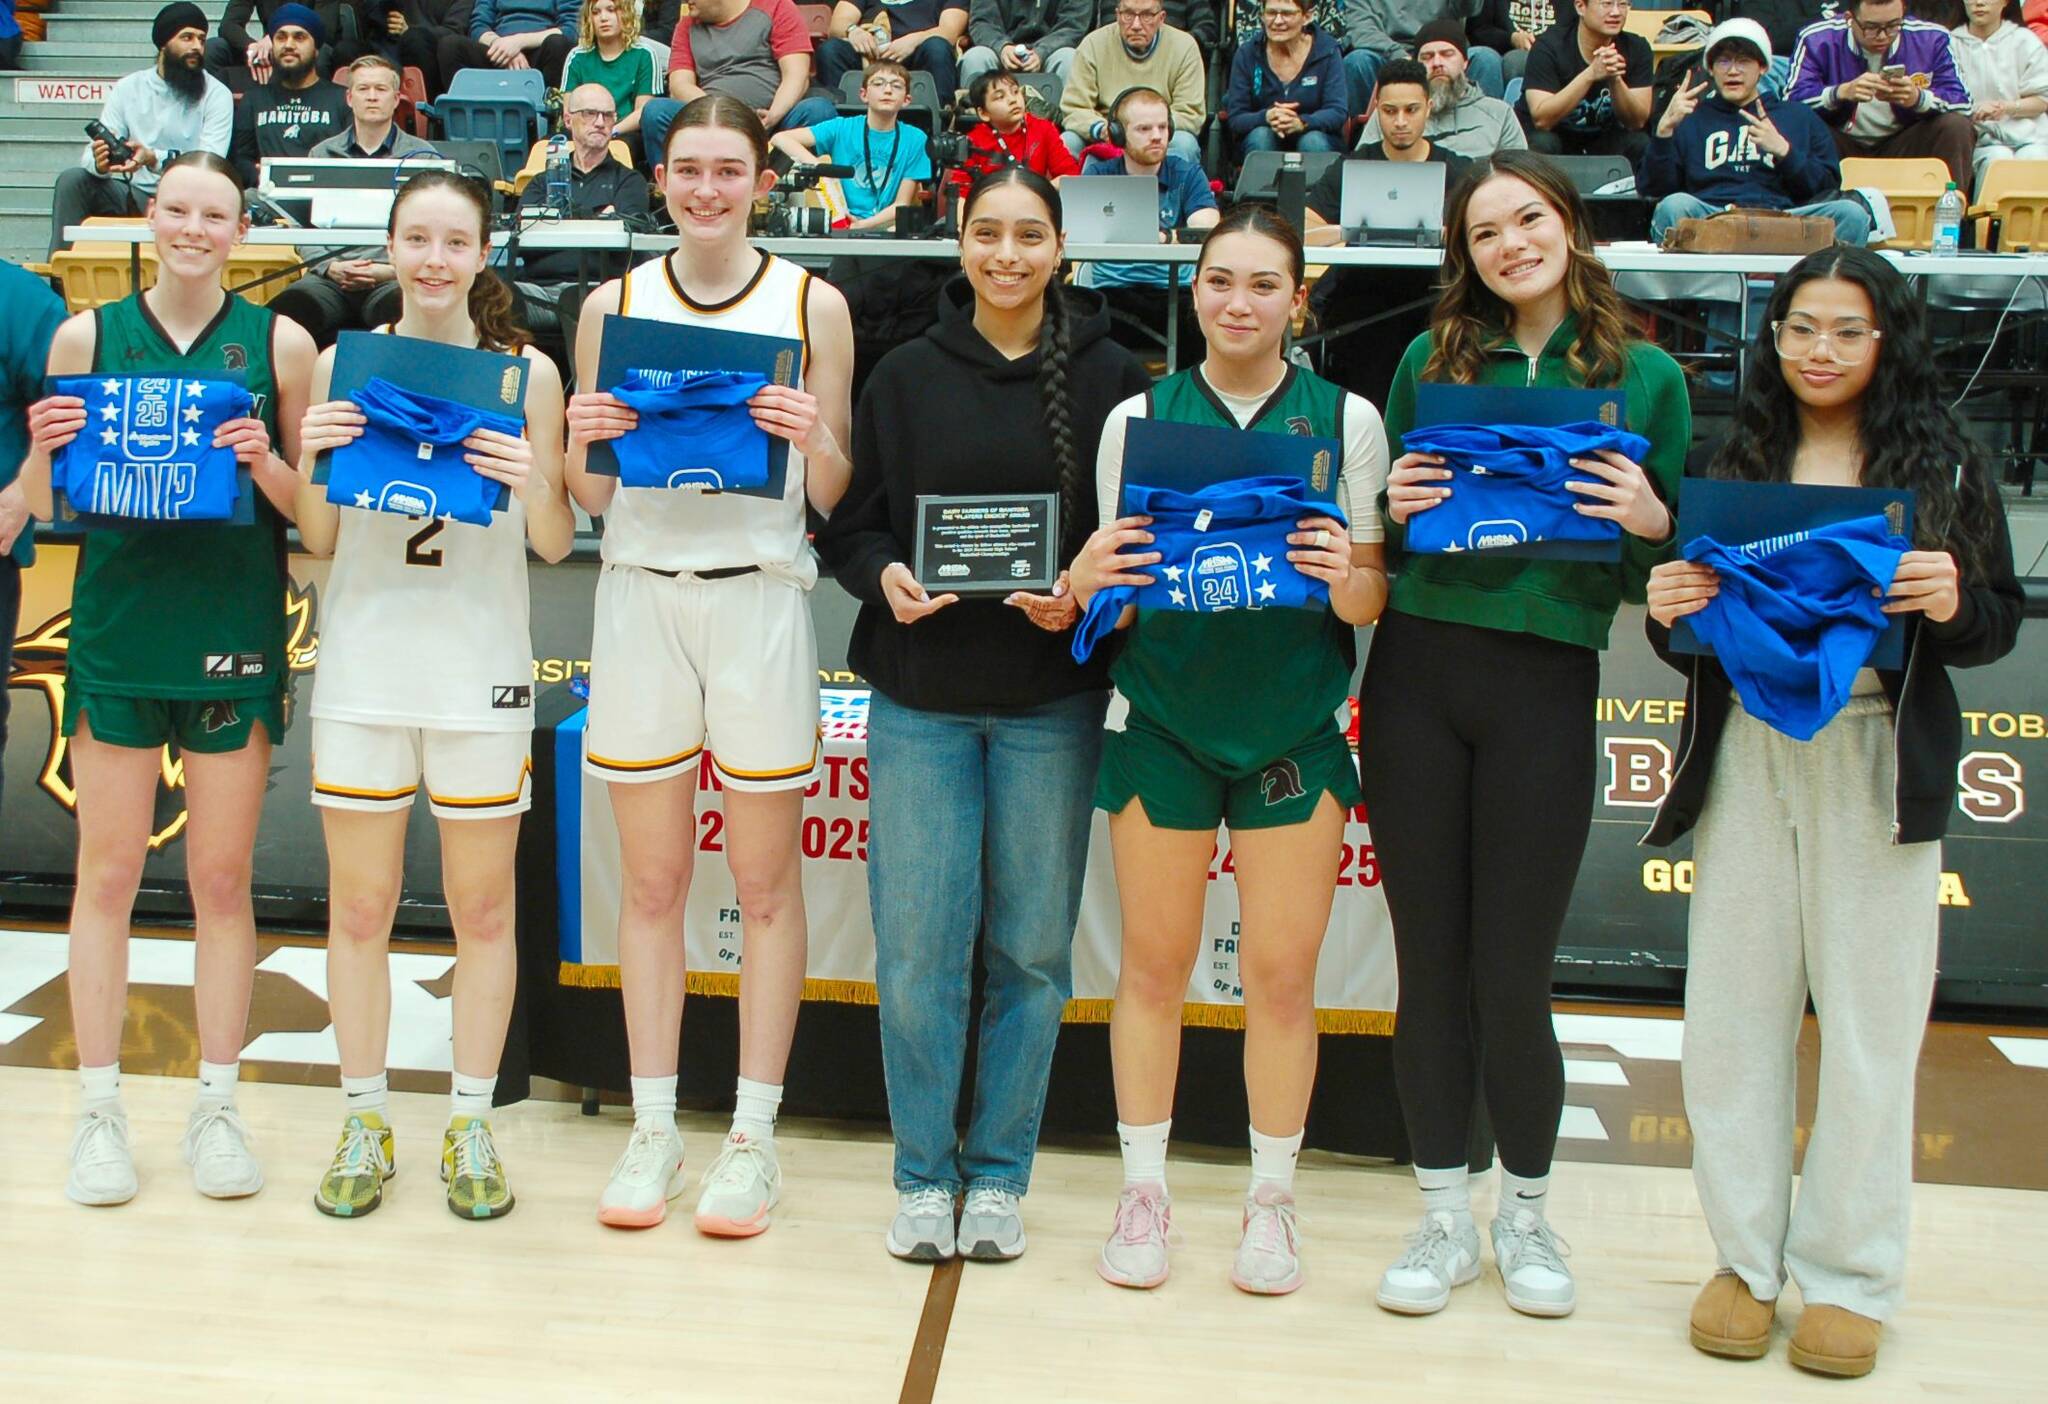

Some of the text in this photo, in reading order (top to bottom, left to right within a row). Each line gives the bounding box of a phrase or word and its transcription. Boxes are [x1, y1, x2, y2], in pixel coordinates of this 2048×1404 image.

[38, 84, 102, 100] WATCH
[257, 110, 331, 127] MANITOBA
[136, 400, 167, 427] 25
[92, 461, 197, 520] MVP
[405, 514, 445, 568] 2
[1202, 575, 1239, 605] 24
[242, 663, 264, 676] MD
[1961, 711, 2048, 739] TOB
[718, 947, 736, 961] OF
[1214, 938, 1240, 954] FA
[1213, 978, 1231, 993] OF
